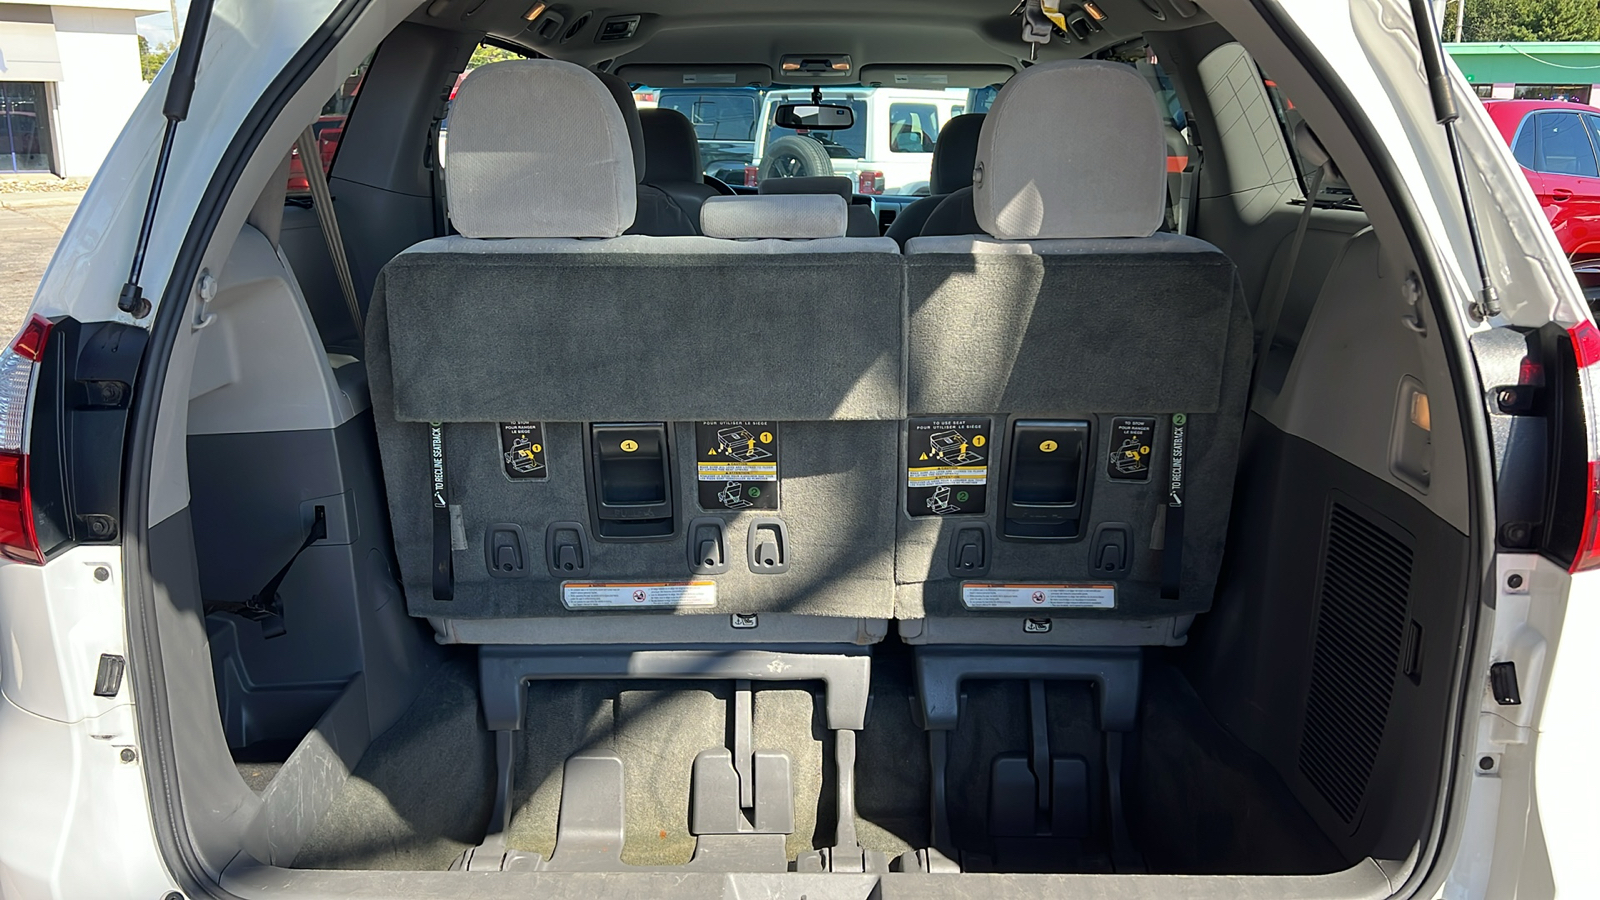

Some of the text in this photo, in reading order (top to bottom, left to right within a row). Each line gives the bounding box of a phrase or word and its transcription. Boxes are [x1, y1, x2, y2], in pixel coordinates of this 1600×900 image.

[432, 428, 442, 458] SEATBACK
[434, 458, 444, 482] RECLINE
[1172, 427, 1183, 490] TO RECLINE SEATBACK
